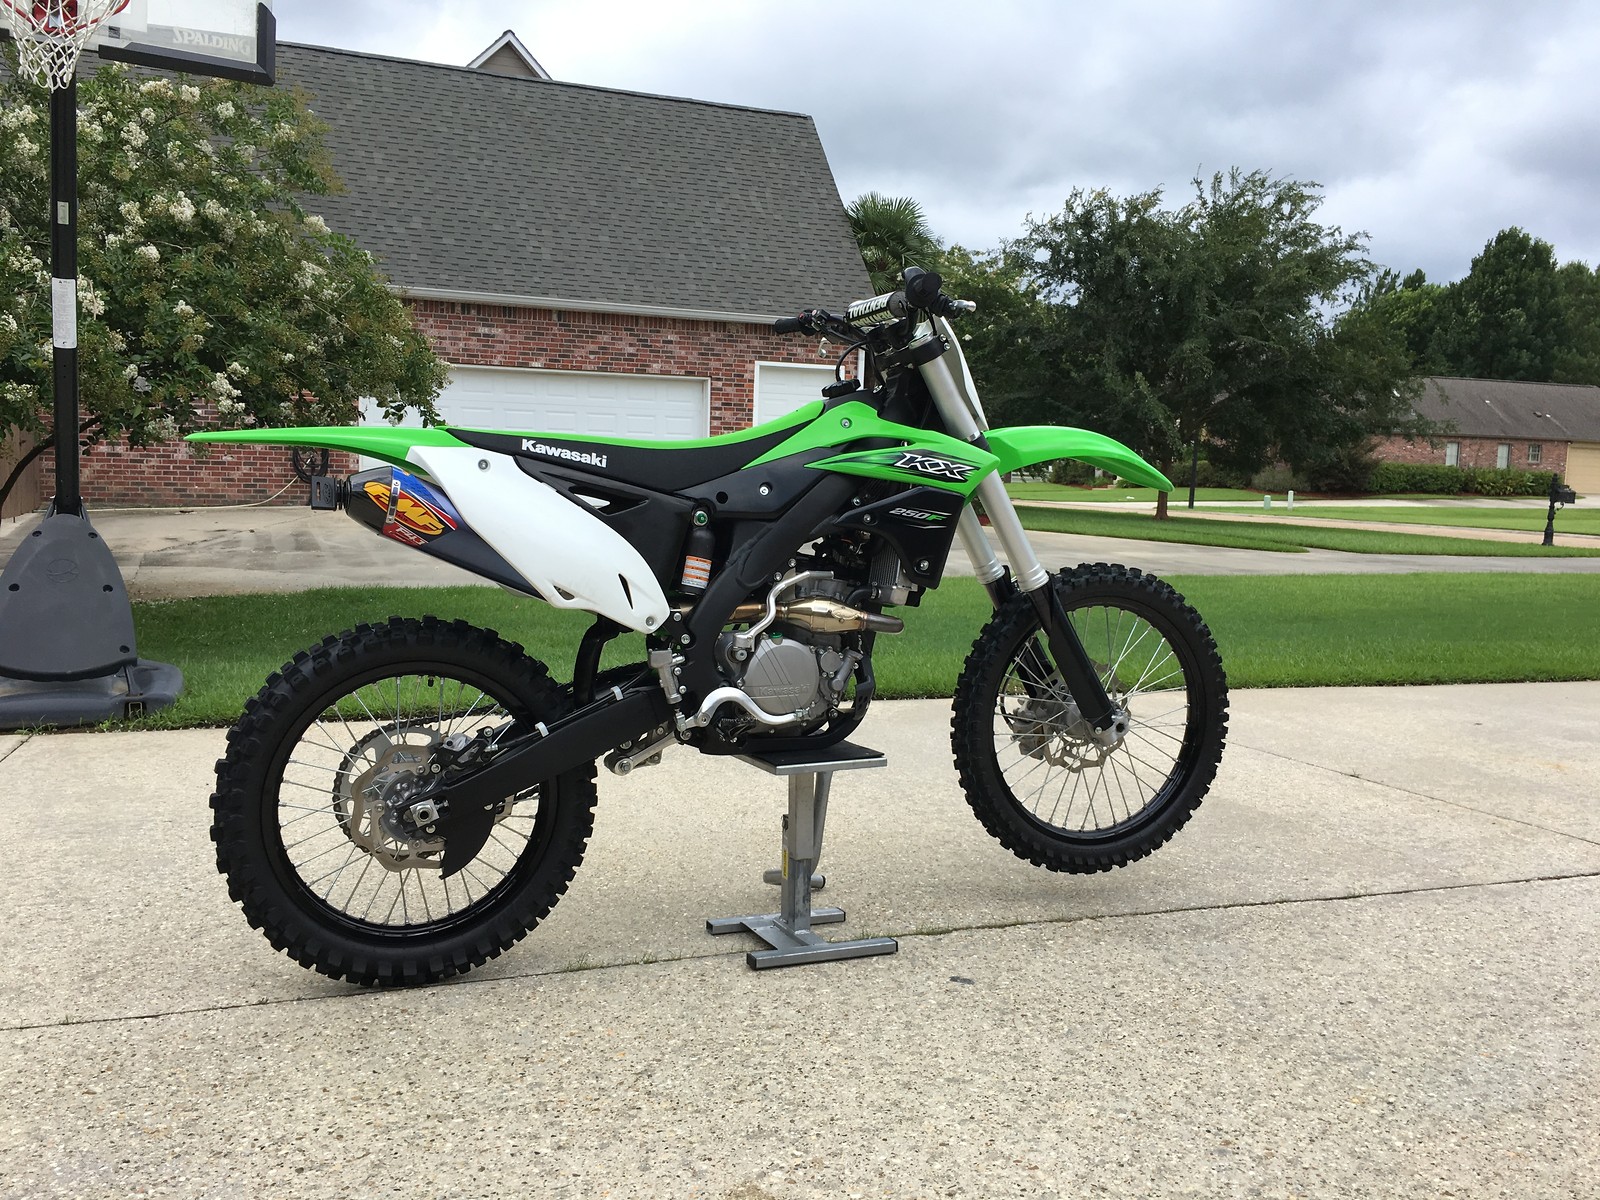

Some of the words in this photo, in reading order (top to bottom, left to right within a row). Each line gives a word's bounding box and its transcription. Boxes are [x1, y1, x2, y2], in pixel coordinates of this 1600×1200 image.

[172, 27, 251, 56] SPALDING
[521, 438, 607, 468] Kawasaki
[894, 452, 976, 481] KX
[889, 507, 947, 521] 250F
